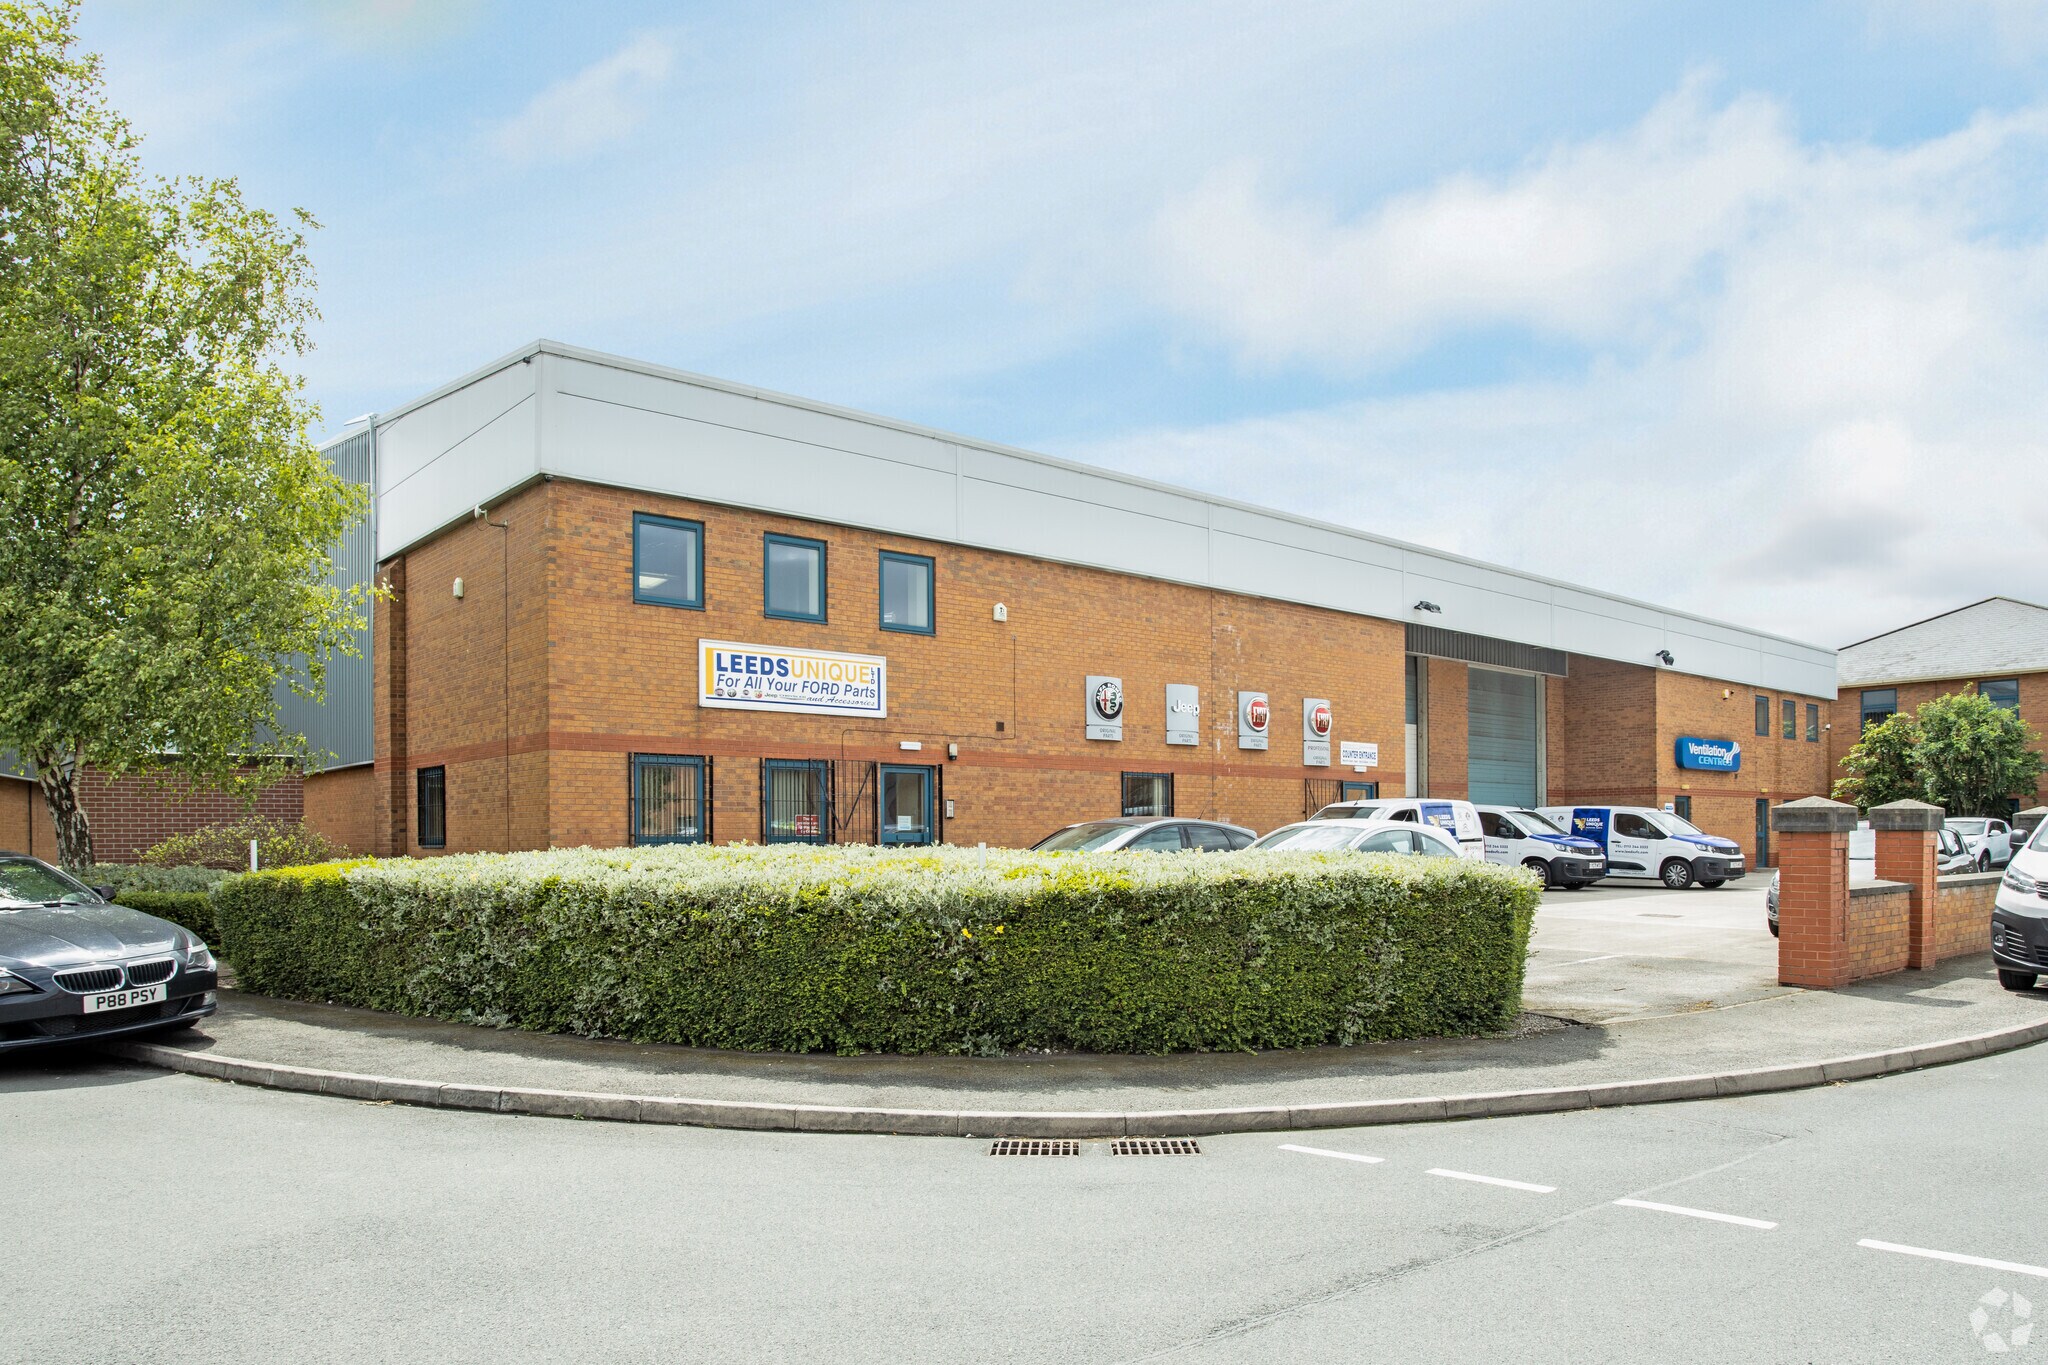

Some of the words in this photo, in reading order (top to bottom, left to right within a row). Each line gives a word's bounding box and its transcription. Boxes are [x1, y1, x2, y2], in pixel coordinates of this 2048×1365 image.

[716, 674, 740, 687] For
[743, 675, 763, 690] All
[766, 677, 798, 693] Your
[801, 680, 840, 696] FORD
[843, 683, 876, 699] Parts
[1171, 699, 1200, 717] Jeep
[1688, 742, 1726, 756] Ventilation
[96, 995, 127, 1010] P88
[130, 988, 156, 1004] PSY
